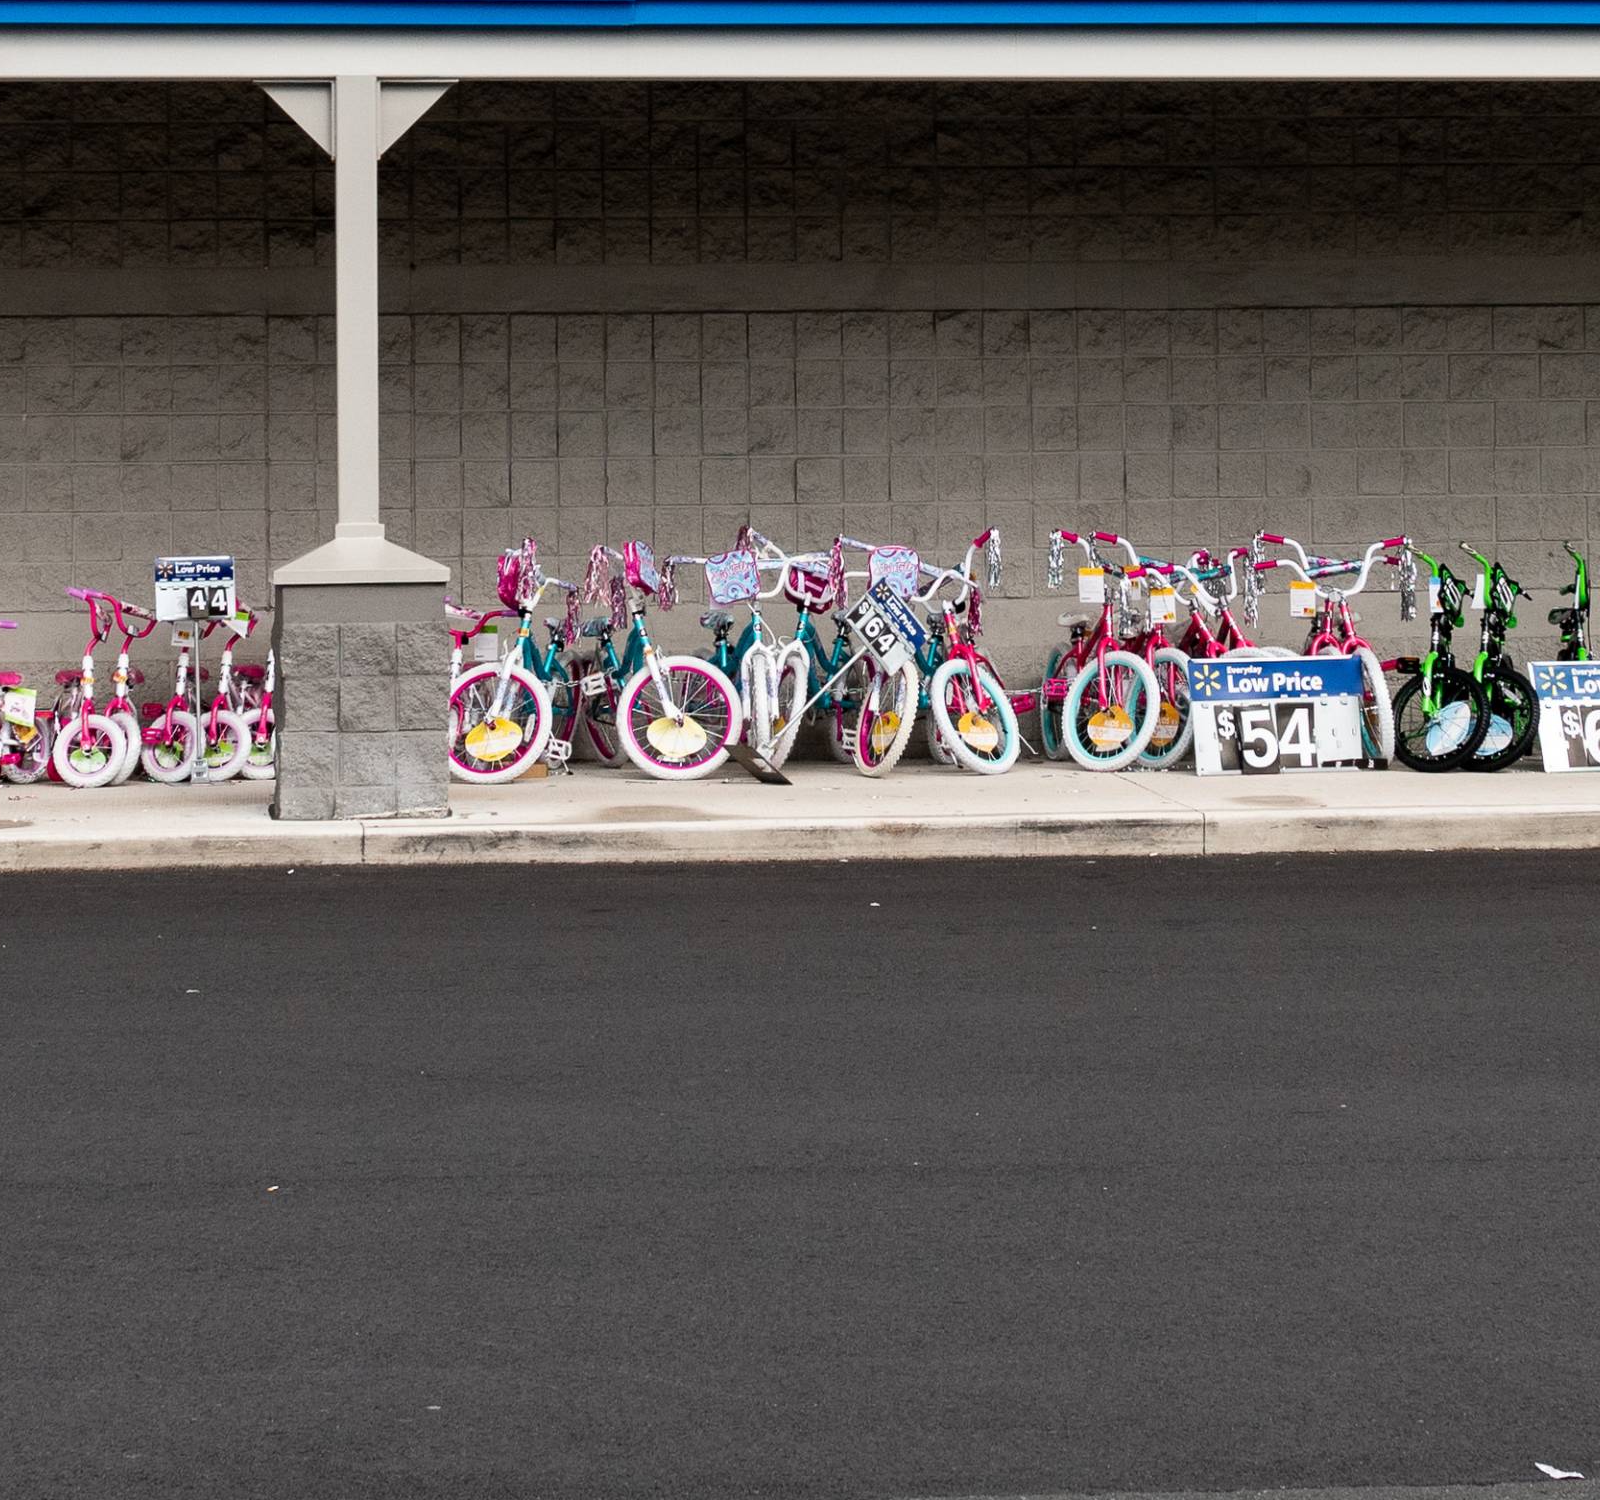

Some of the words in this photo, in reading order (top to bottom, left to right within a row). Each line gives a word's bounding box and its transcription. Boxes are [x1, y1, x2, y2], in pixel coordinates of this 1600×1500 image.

[175, 565, 195, 574] Low
[196, 564, 220, 573] Price
[190, 589, 227, 611] 44
[1226, 665, 1263, 675] Everyday
[1226, 675, 1269, 693] Low
[1272, 671, 1323, 692] Price
[1217, 707, 1318, 768] $54
